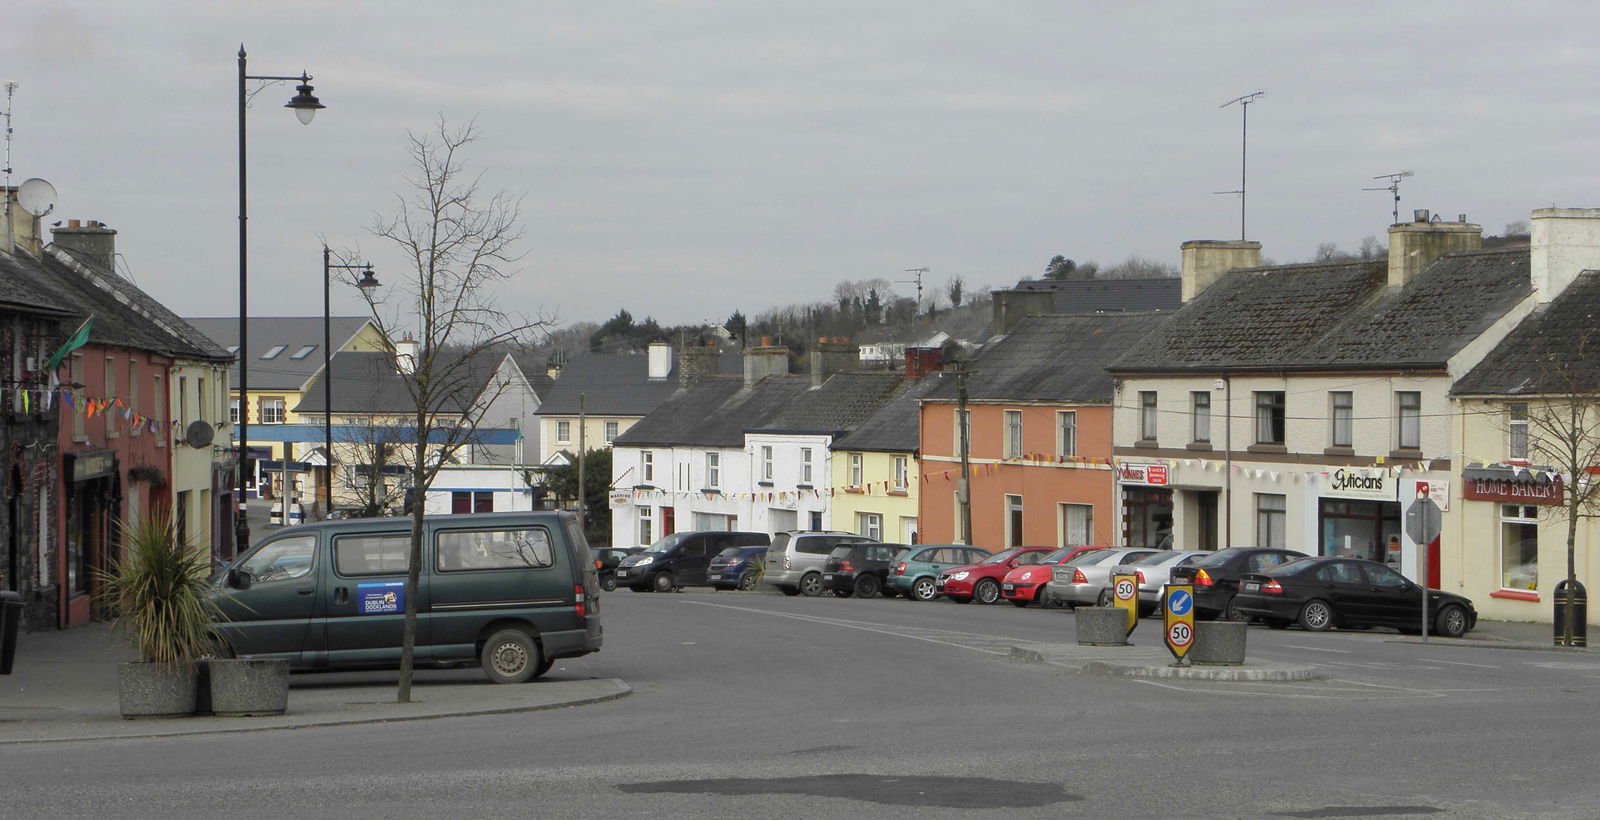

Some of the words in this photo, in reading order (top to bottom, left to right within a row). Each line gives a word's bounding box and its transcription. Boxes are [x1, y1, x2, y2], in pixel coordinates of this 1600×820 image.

[1332, 468, 1382, 490] Opticians
[1476, 480, 1507, 495] HOME
[1511, 483, 1558, 499] BAKERY
[1119, 584, 1132, 594] 50
[1173, 627, 1189, 639] 50
